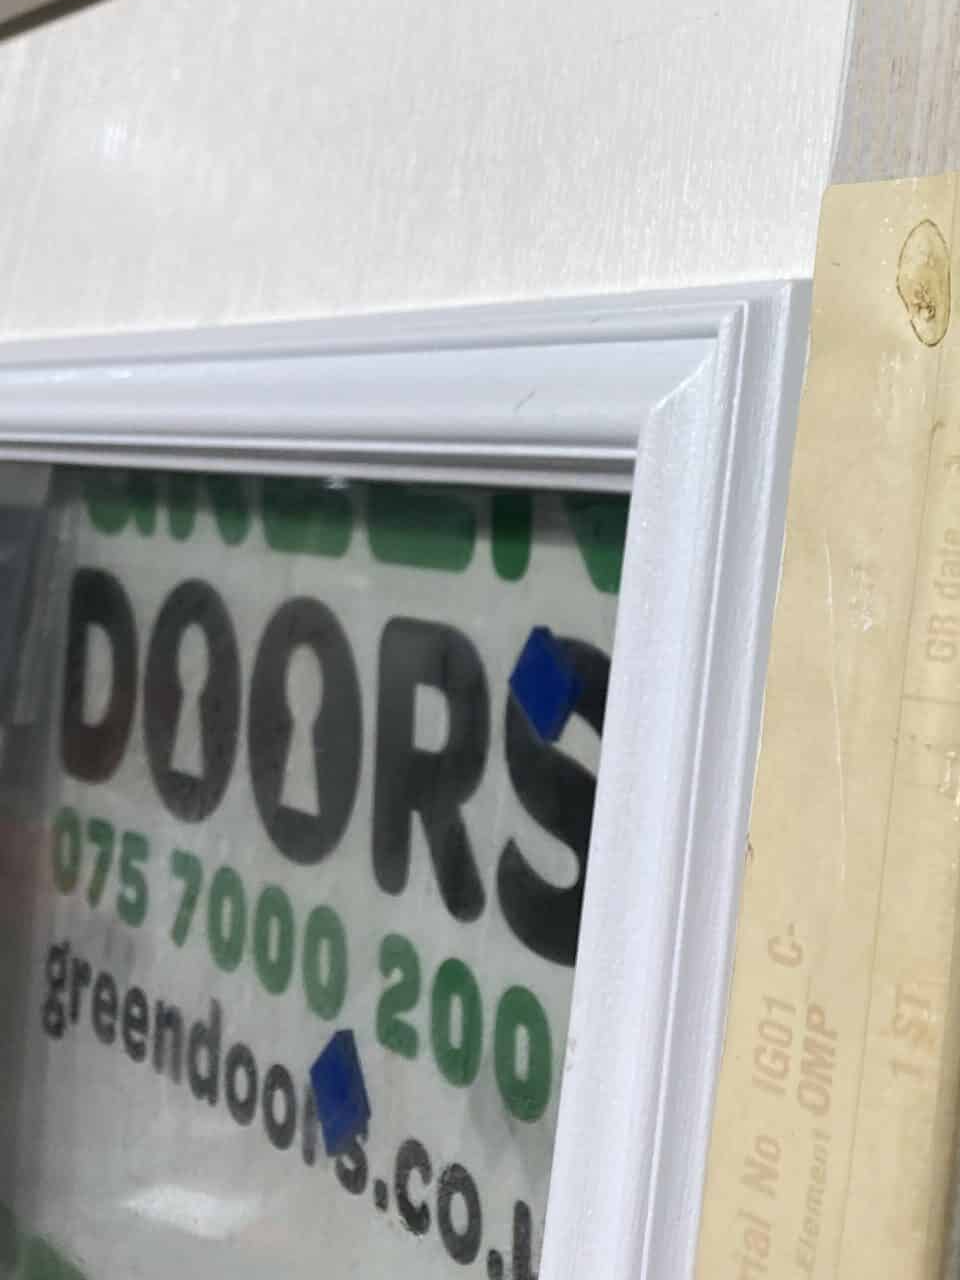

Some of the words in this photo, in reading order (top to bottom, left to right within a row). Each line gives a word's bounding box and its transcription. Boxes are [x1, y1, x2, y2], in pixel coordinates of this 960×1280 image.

[51, 805, 149, 928] 075
[170, 848, 348, 1021] 7000
[796, 1001, 839, 1118] OMP
[737, 1133, 782, 1200] No
